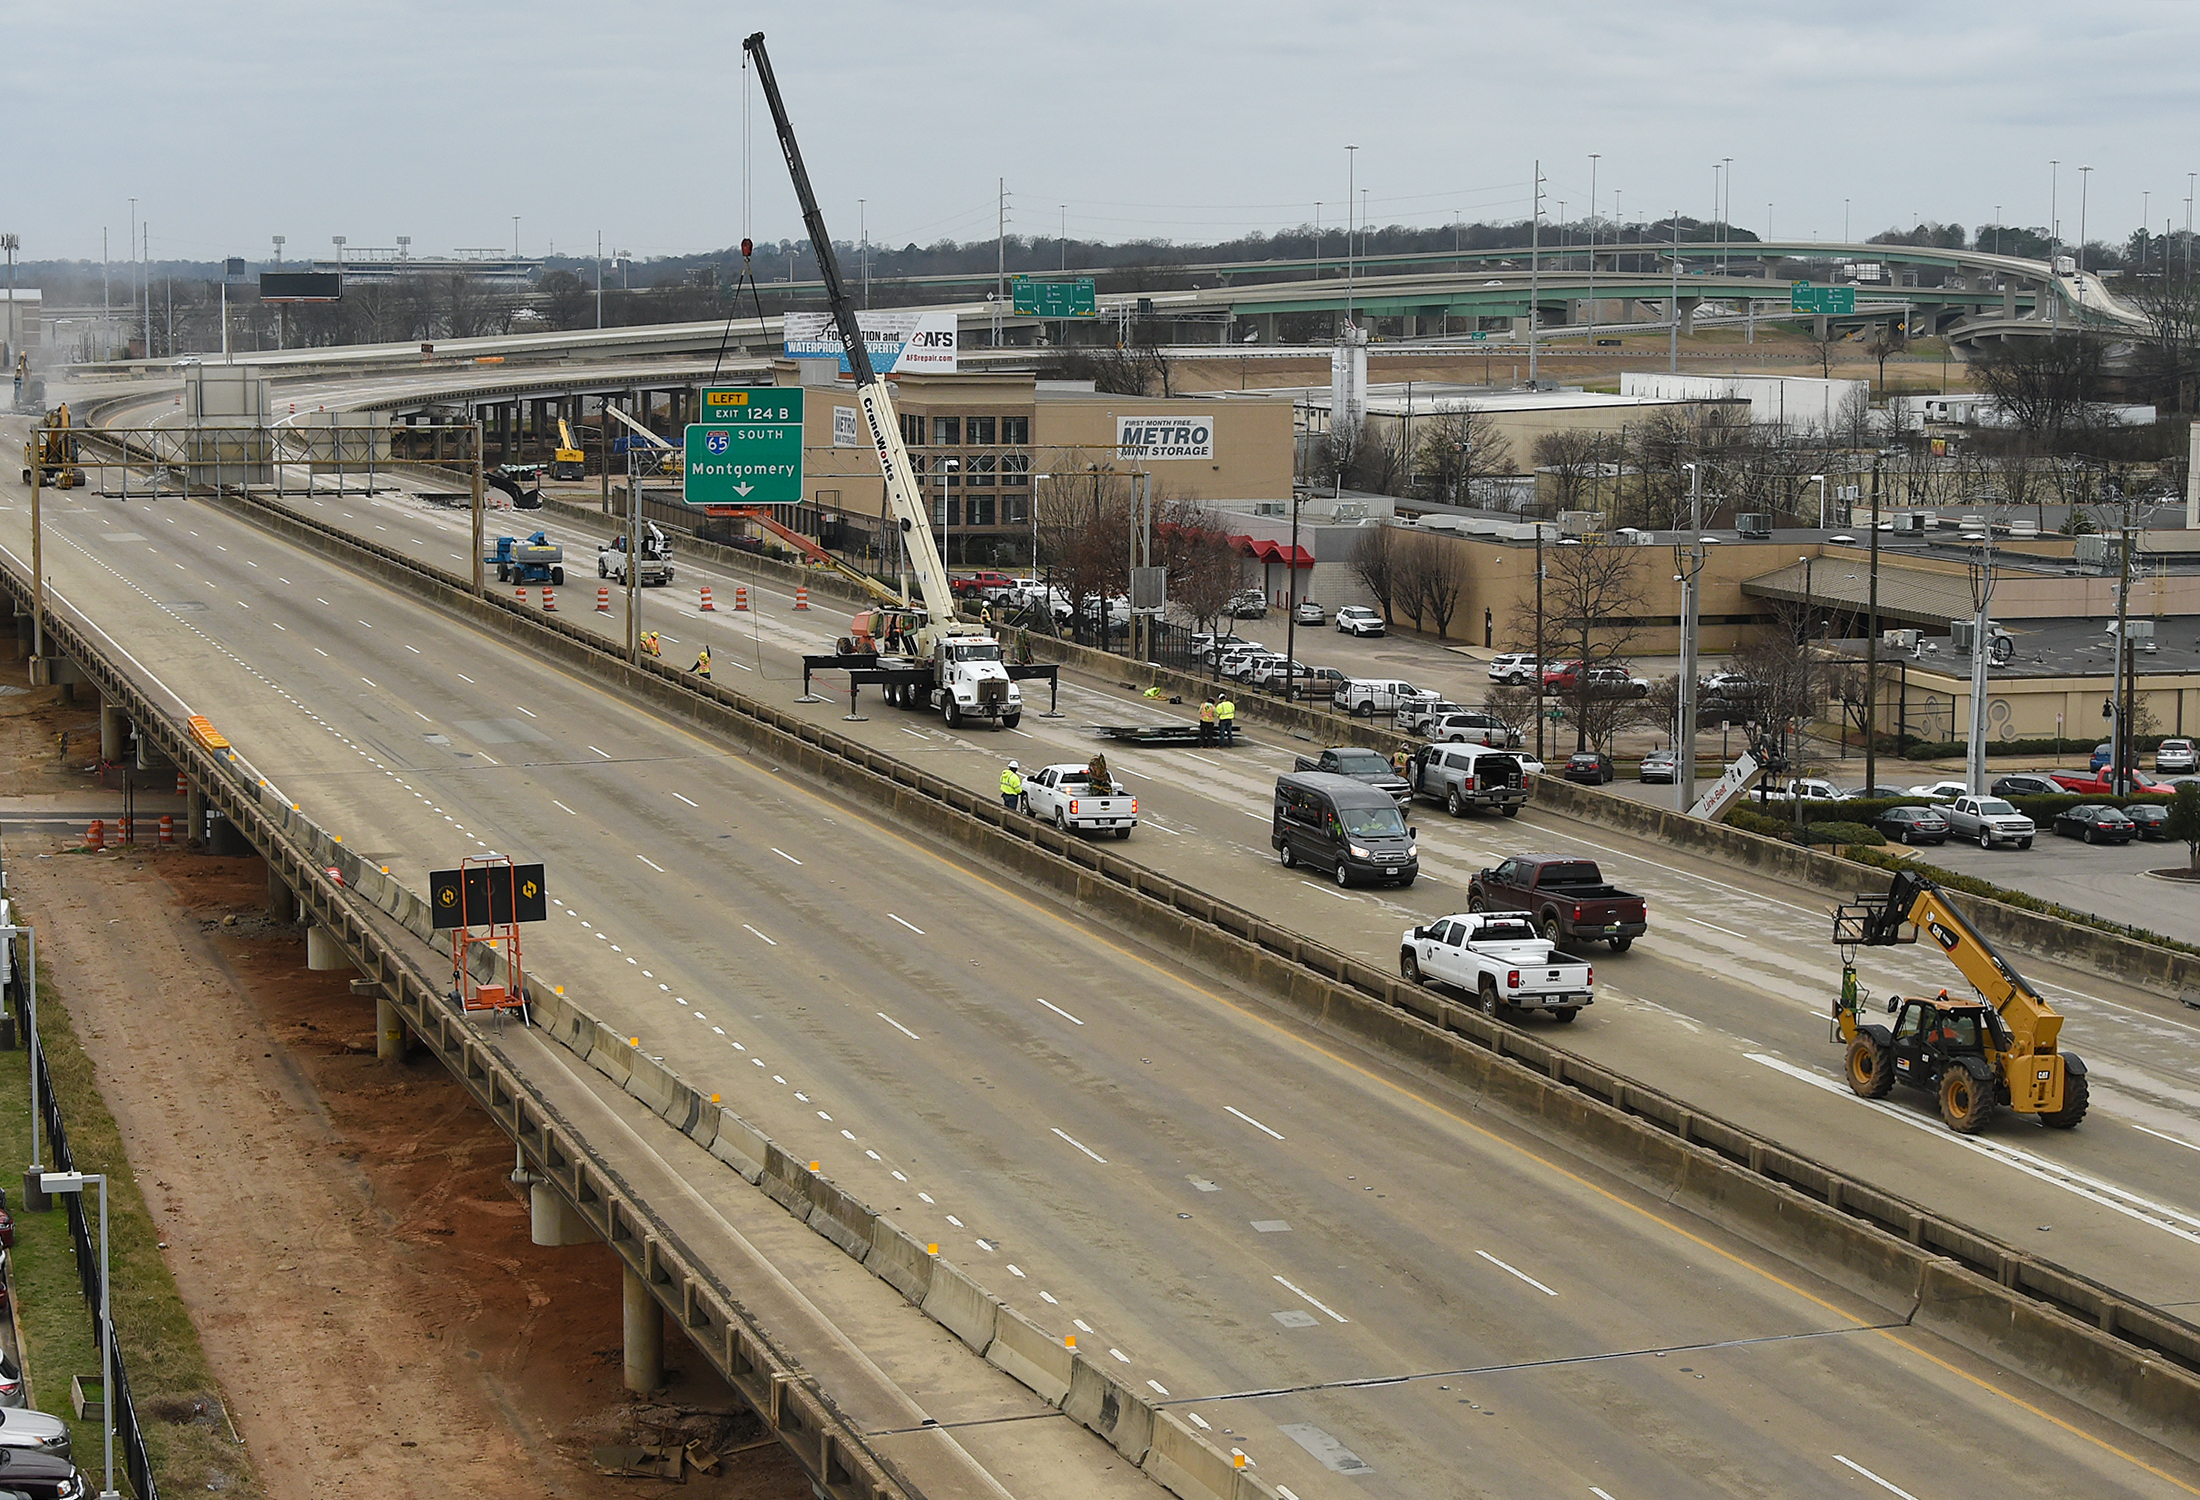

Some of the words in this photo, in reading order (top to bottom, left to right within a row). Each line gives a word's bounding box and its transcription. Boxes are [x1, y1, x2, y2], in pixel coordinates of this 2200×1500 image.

[827, 330, 881, 342] FOTION
[882, 331, 900, 342] and
[923, 331, 954, 348] AFS
[787, 341, 845, 353] WATERPROOF
[906, 354, 953, 363] AFSrepair.com
[713, 394, 742, 404] LEFT
[715, 409, 739, 418] EXIT
[747, 408, 774, 420] 124
[779, 407, 789, 420] B
[835, 415, 857, 435] METRO
[738, 430, 783, 440] SOUTH
[863, 397, 895, 482] CraneWorks
[1122, 427, 1209, 445] METRO
[707, 437, 728, 451] 65
[1121, 446, 1149, 456] MINI
[1151, 446, 1209, 456] STORAGE
[692, 462, 795, 479] Montgomery
[1703, 783, 1728, 812] Link-Belt
[2037, 1071, 2049, 1080] CAT
